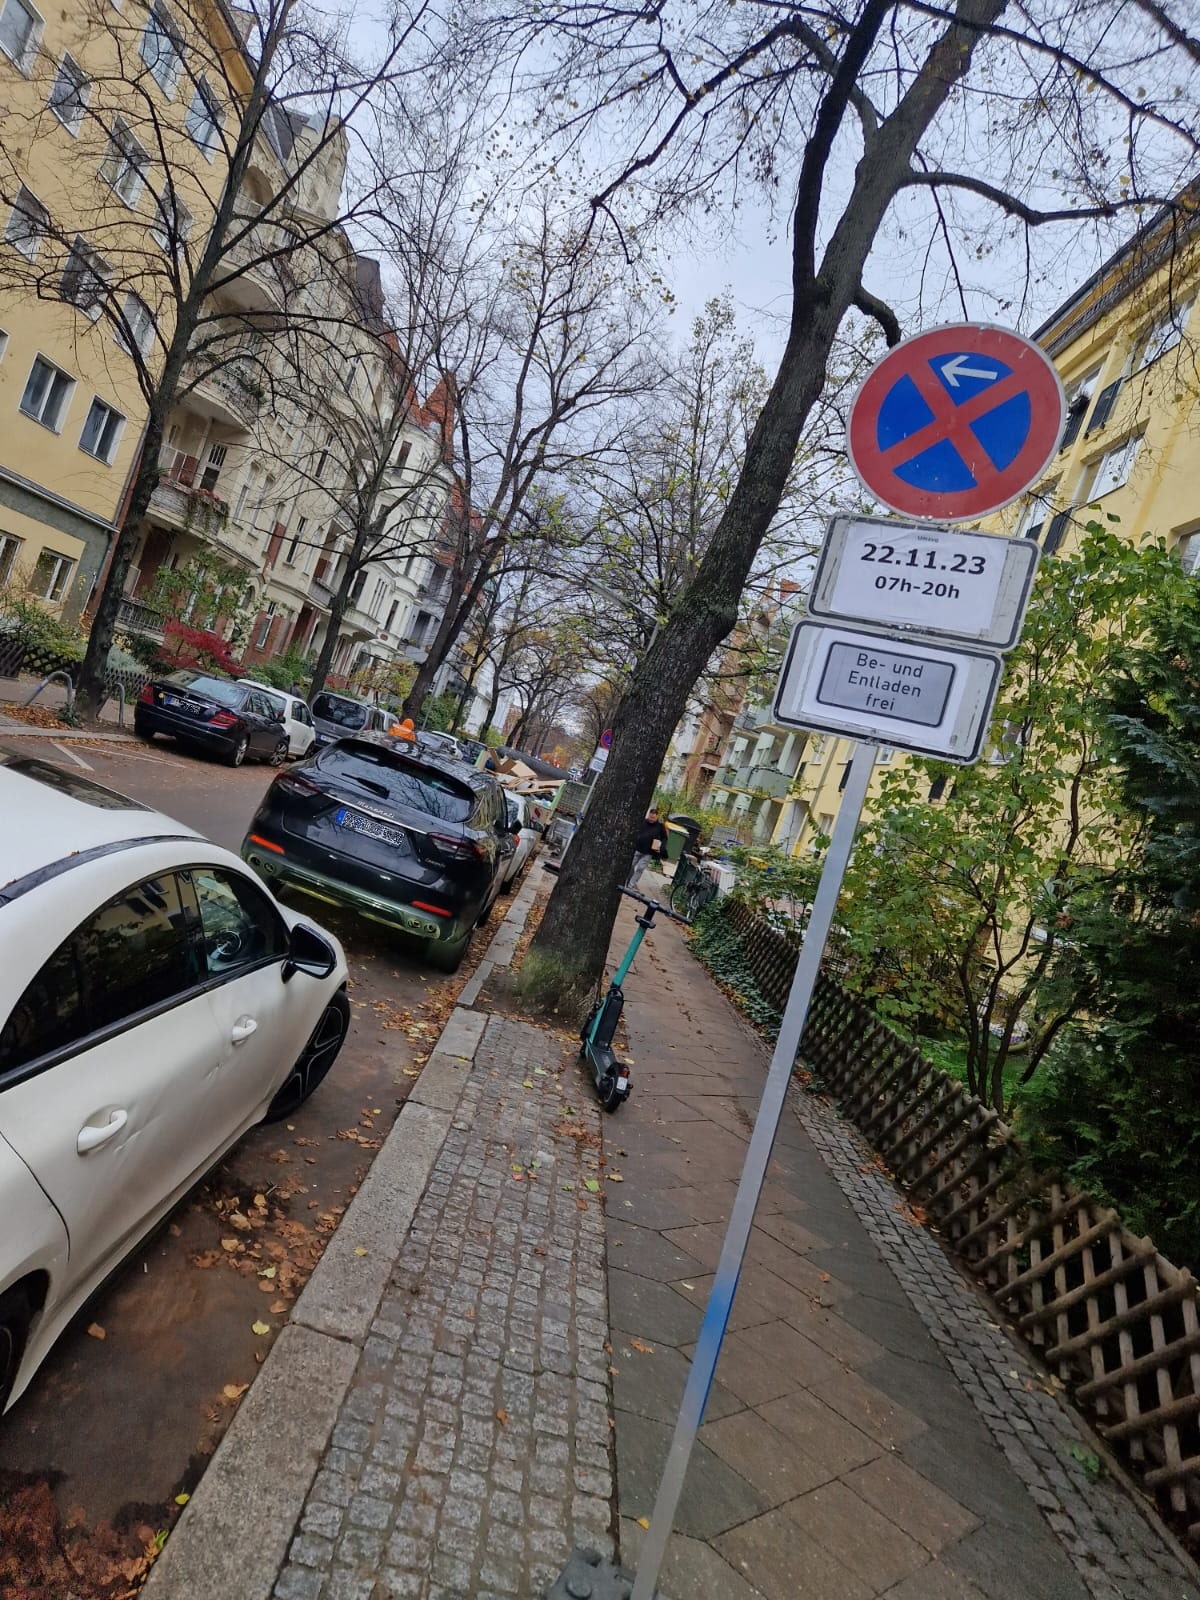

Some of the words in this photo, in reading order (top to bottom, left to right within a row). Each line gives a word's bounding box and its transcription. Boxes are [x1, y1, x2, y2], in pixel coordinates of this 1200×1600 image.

[860, 543, 987, 576] 22.11.23
[874, 575, 961, 600] 07h-20h
[856, 652, 887, 670] Be-
[892, 663, 924, 679] und
[847, 670, 922, 698] Entladen
[865, 693, 896, 712] frei
